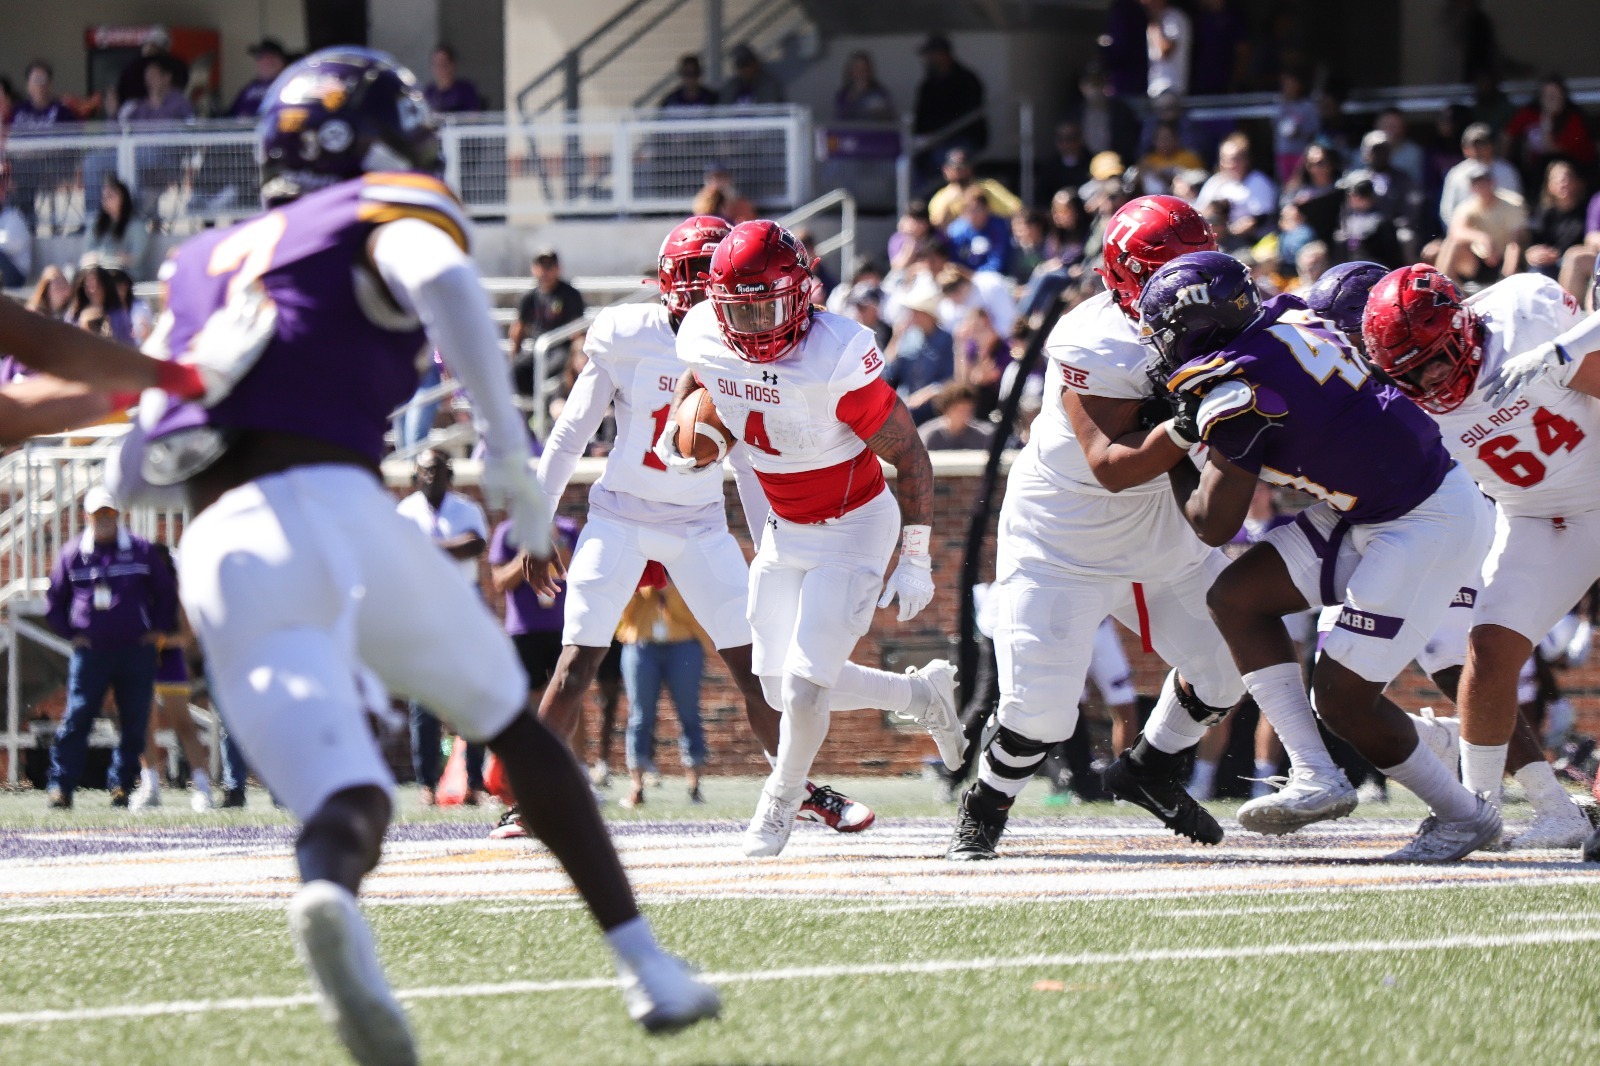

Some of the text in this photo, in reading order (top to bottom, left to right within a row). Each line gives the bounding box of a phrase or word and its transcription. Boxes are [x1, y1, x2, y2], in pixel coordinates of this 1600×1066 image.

[1107, 213, 1141, 252] 77
[207, 209, 287, 318] 7
[862, 350, 881, 370] SR
[658, 376, 678, 393] SU
[1062, 367, 1088, 387] SR
[717, 378, 781, 405] SUL ROSS
[743, 409, 783, 457] 4
[1460, 423, 1494, 448] SUL
[1476, 405, 1588, 489] 64
[1452, 591, 1473, 605] HB
[1340, 610, 1376, 632] MHB
